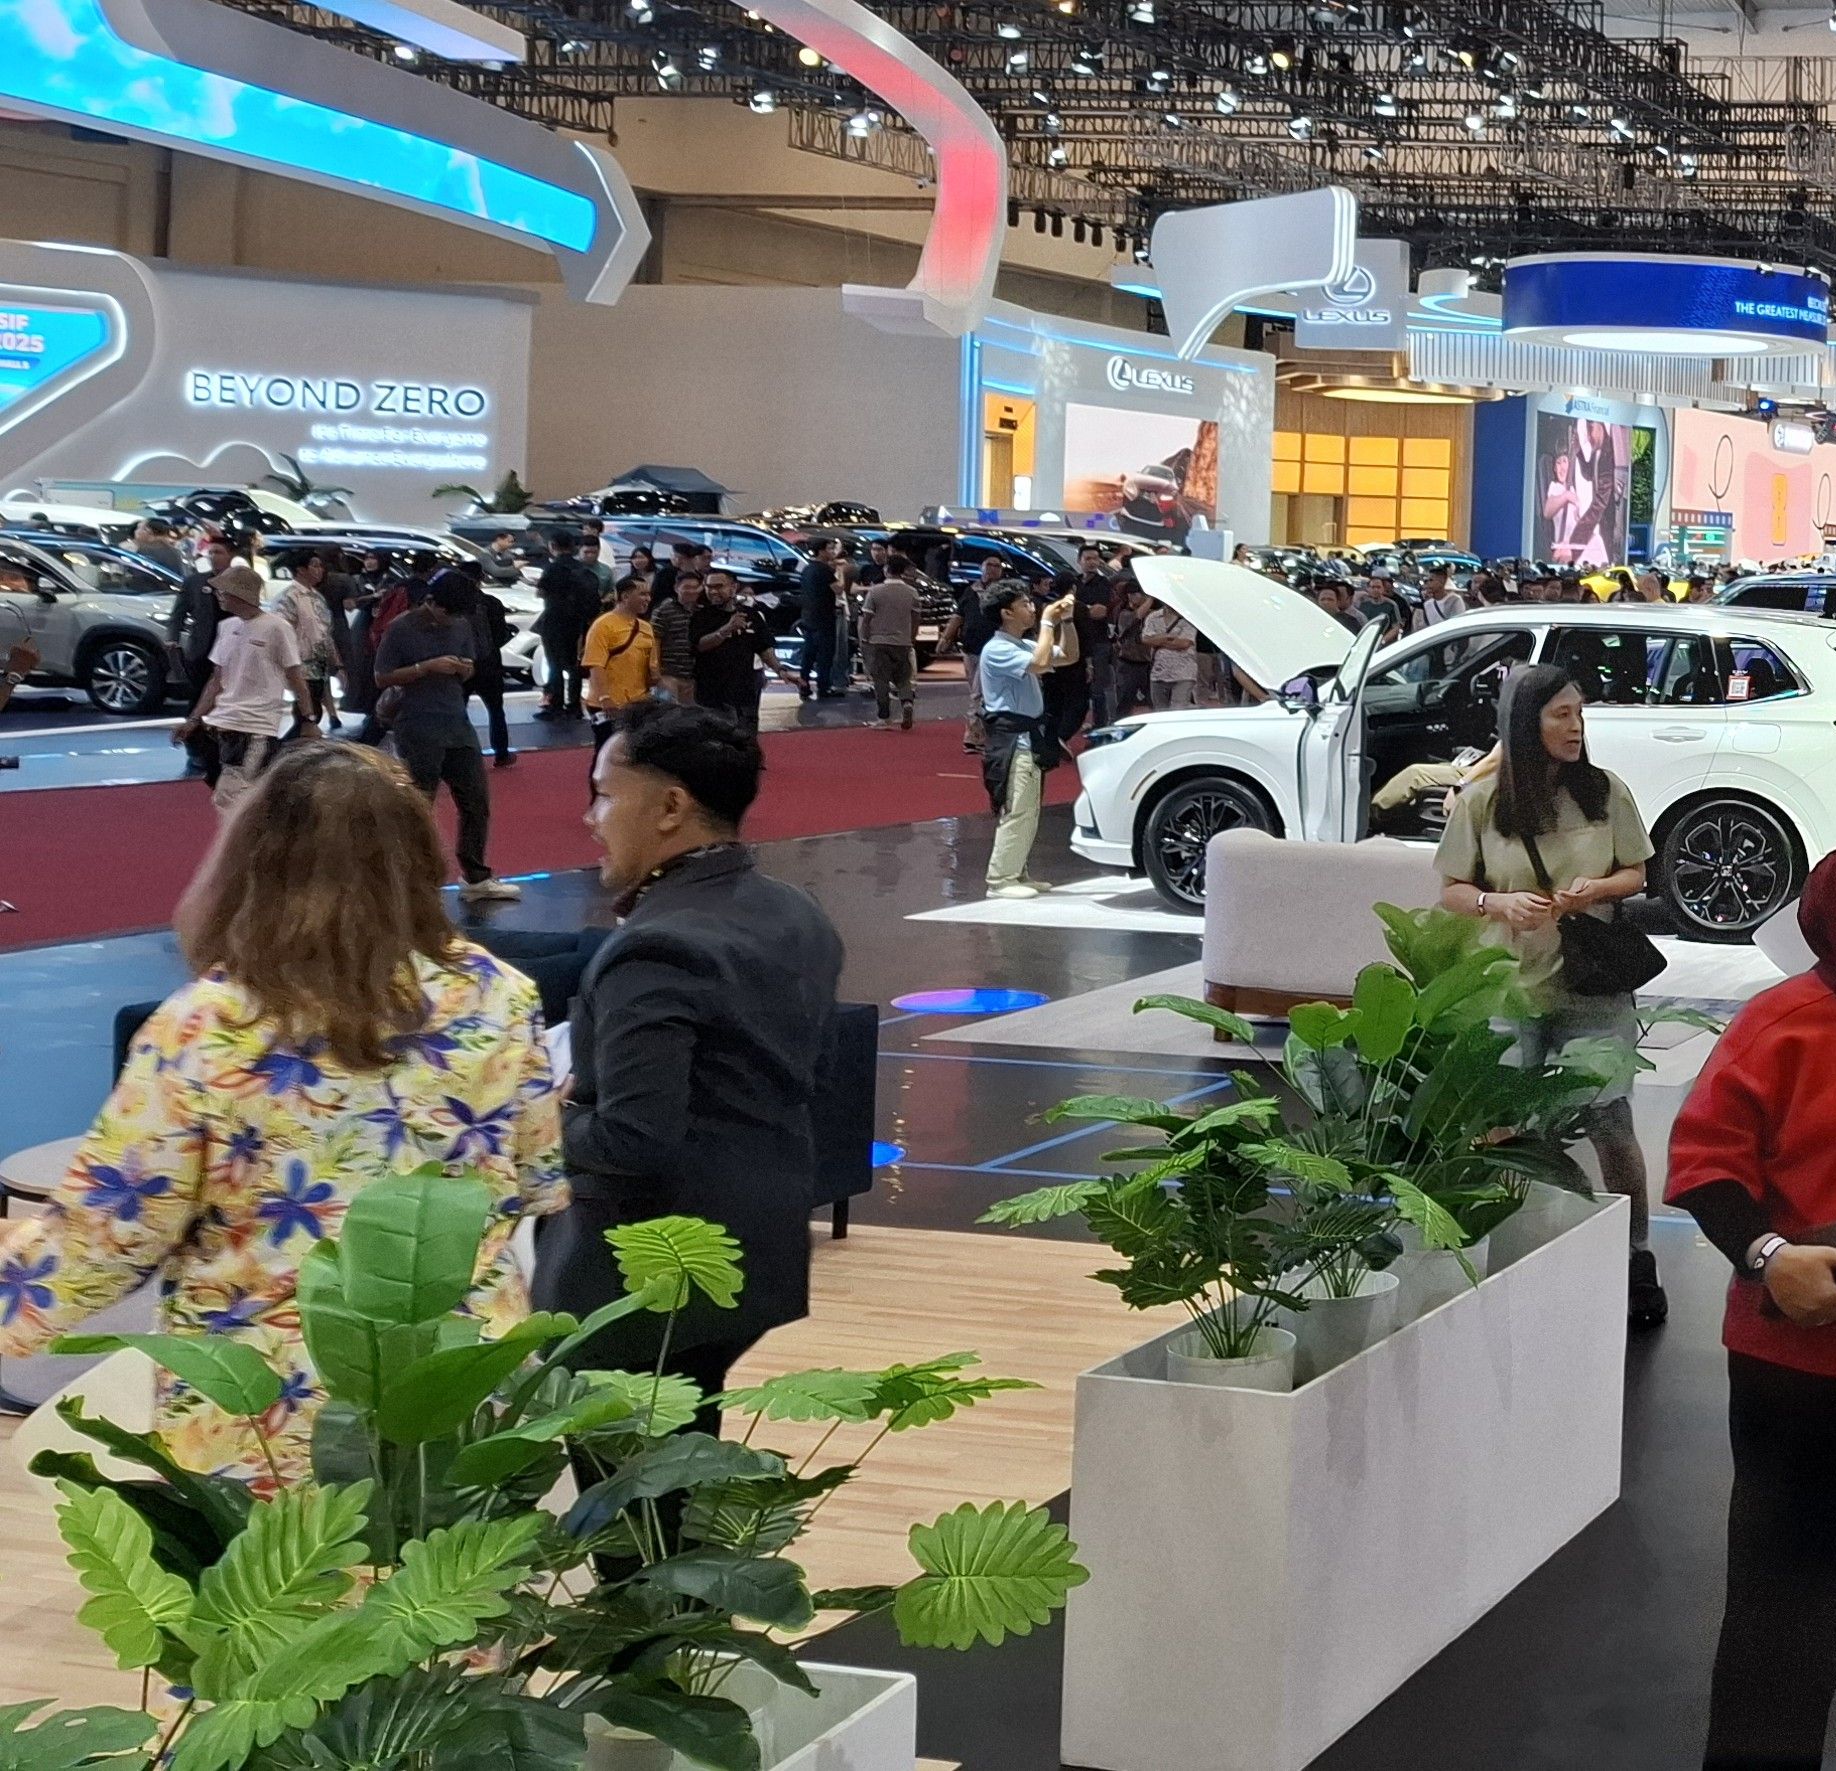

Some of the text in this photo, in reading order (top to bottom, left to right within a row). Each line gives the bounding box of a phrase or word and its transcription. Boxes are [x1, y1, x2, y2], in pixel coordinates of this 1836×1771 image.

[1303, 309, 1391, 325] LEXUS
[1735, 301, 1755, 315] THE
[1756, 303, 1798, 319] GREATEST
[0, 331, 45, 353] 025
[1131, 366, 1195, 394] LEXUS
[192, 372, 486, 416] BEYOND ZERO
